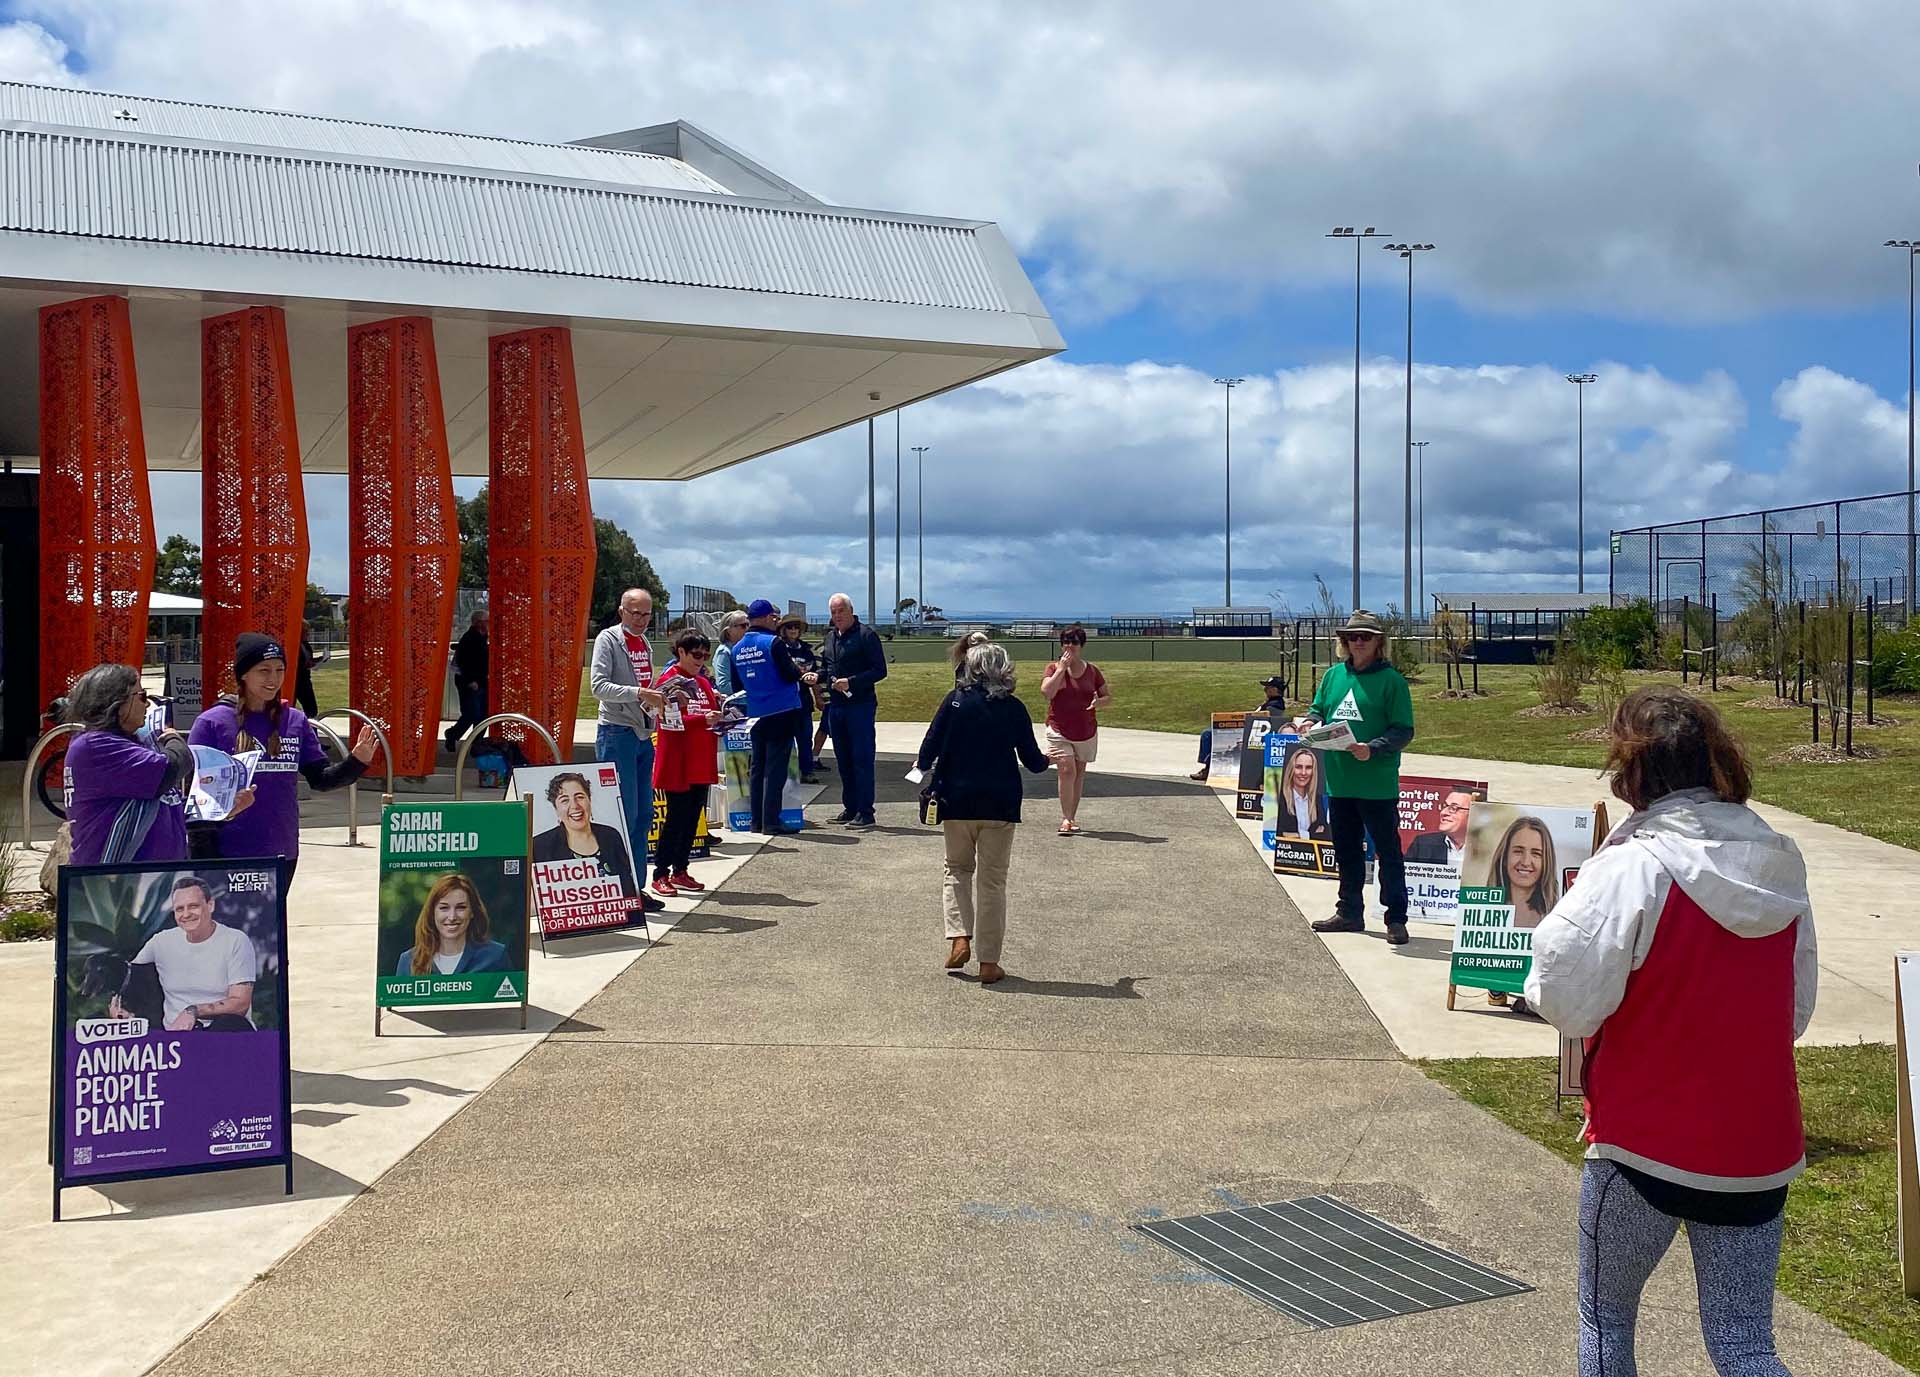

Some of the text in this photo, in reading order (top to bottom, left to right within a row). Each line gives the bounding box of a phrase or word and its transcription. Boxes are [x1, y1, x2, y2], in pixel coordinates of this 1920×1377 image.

[176, 676, 202, 688] Early
[1337, 709, 1358, 717] GREENS
[279, 736, 300, 744] imal
[281, 744, 300, 752] stice
[1399, 790, 1439, 800] on't let
[1413, 801, 1433, 810] get
[390, 812, 442, 831] SARAH
[1414, 821, 1425, 830] it.
[390, 832, 478, 853] MANSFIELD
[1277, 850, 1315, 861] McGRATH
[228, 873, 258, 882] VOTE
[534, 861, 596, 884] Hutch
[538, 880, 620, 906] Hussein
[1466, 891, 1487, 900] VOTE
[542, 899, 639, 919] A BETTER FUTURE
[1413, 899, 1436, 907] ballot
[543, 912, 626, 930] FOR POLWARTH
[1463, 909, 1510, 927] HILARY
[1461, 930, 1533, 950] MCALLISTE
[1458, 957, 1523, 969] FOR POLWARTH
[386, 984, 412, 994] VOTE
[433, 981, 472, 992] GREENS
[82, 1022, 129, 1037] VOTE
[76, 1041, 181, 1077] ANIMALS
[76, 1072, 159, 1106] PEOPLE
[76, 1100, 164, 1136] PLANET
[241, 1115, 272, 1124] Animal
[241, 1124, 272, 1132] Justice
